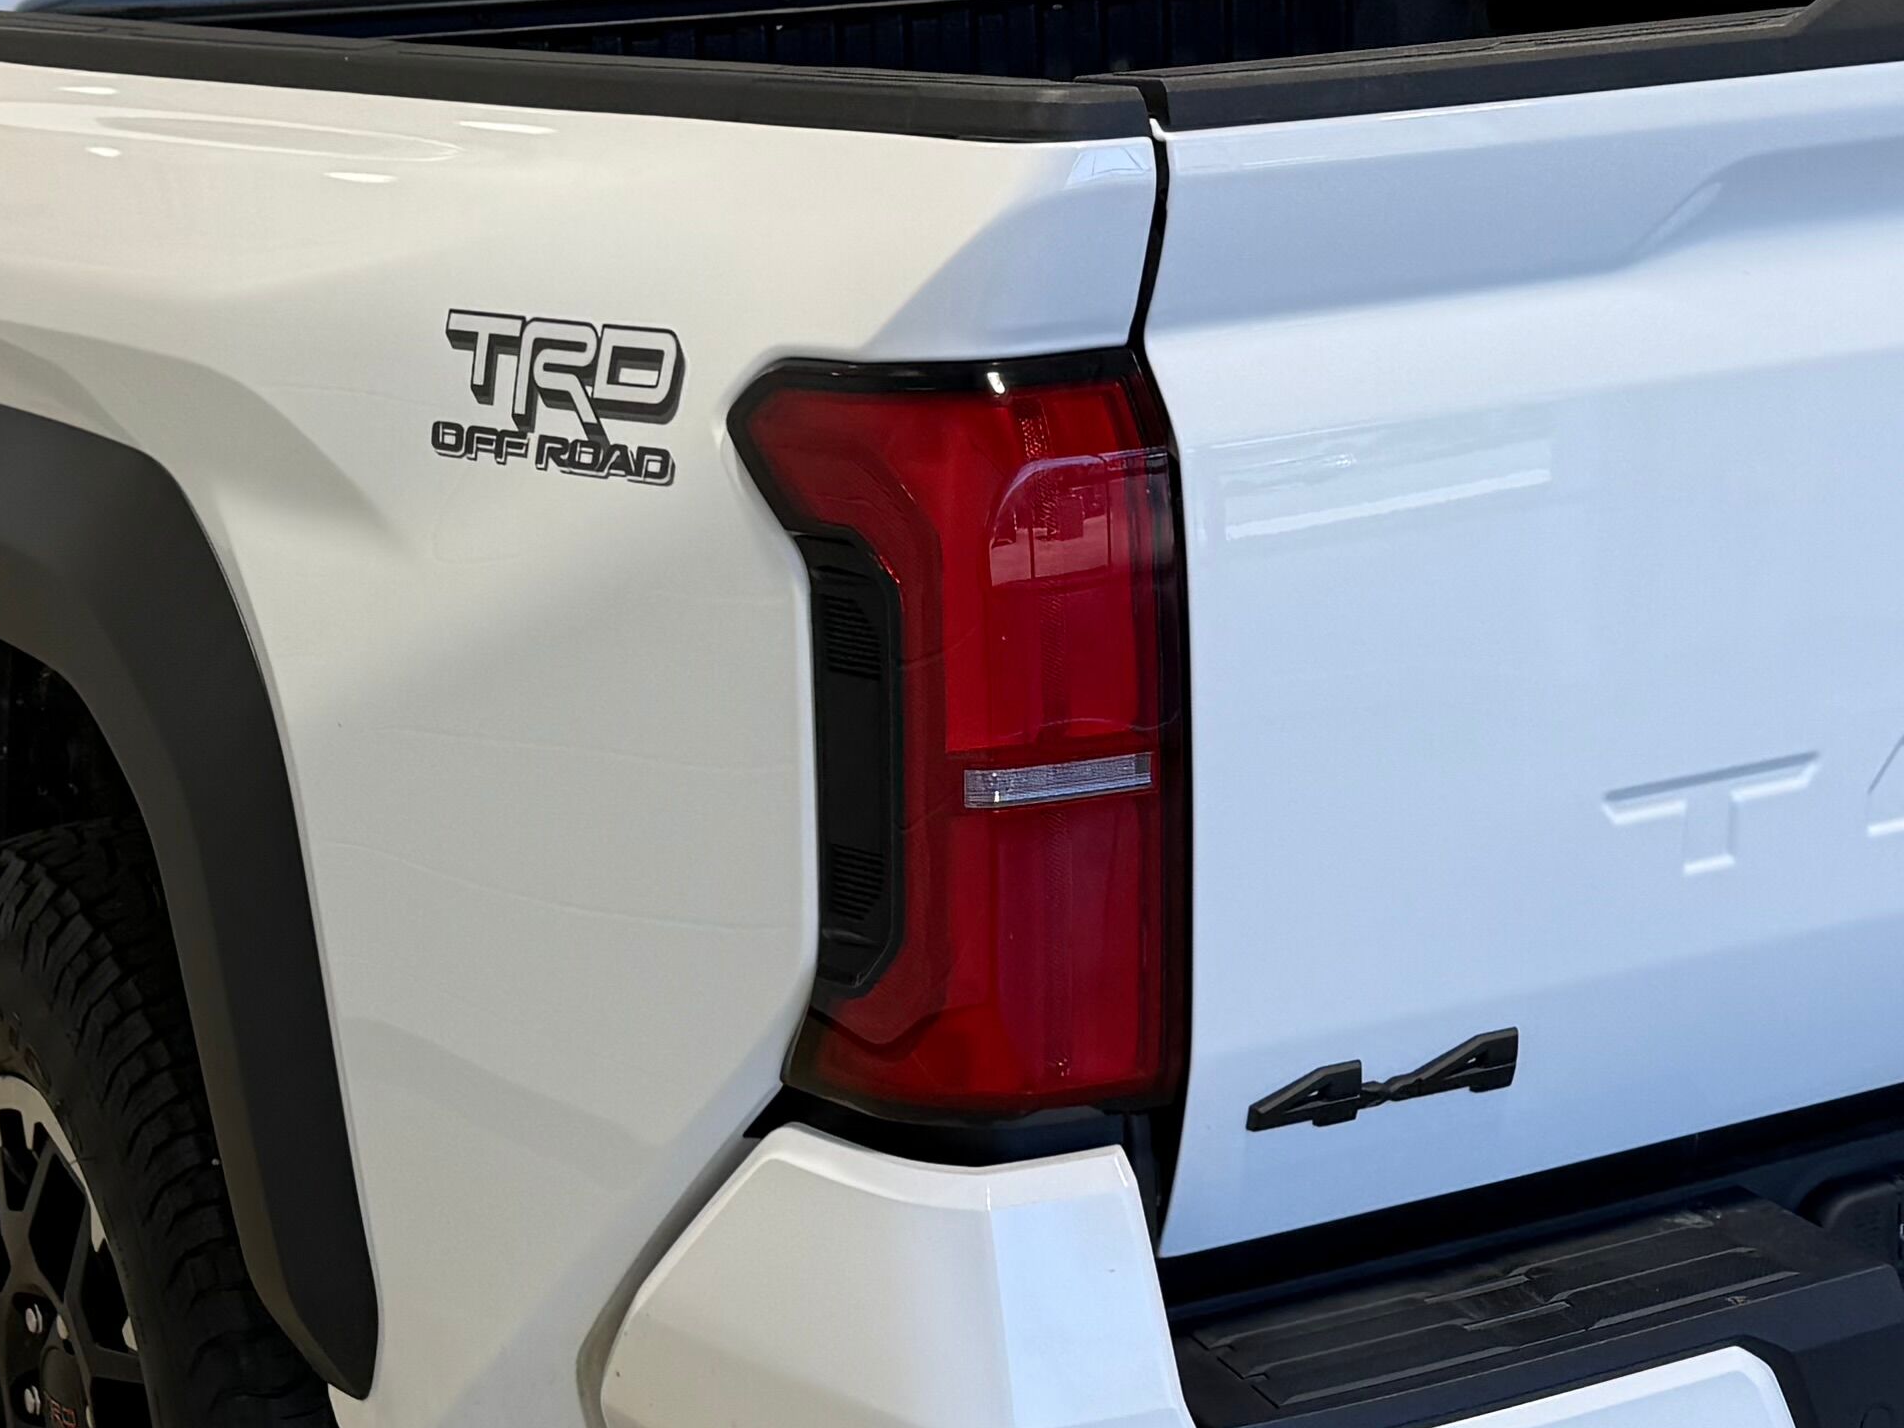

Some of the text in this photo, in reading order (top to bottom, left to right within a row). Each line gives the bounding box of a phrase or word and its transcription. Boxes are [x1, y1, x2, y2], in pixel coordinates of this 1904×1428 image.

[445, 308, 686, 448] TRD
[431, 421, 676, 486] OFF ROAD
